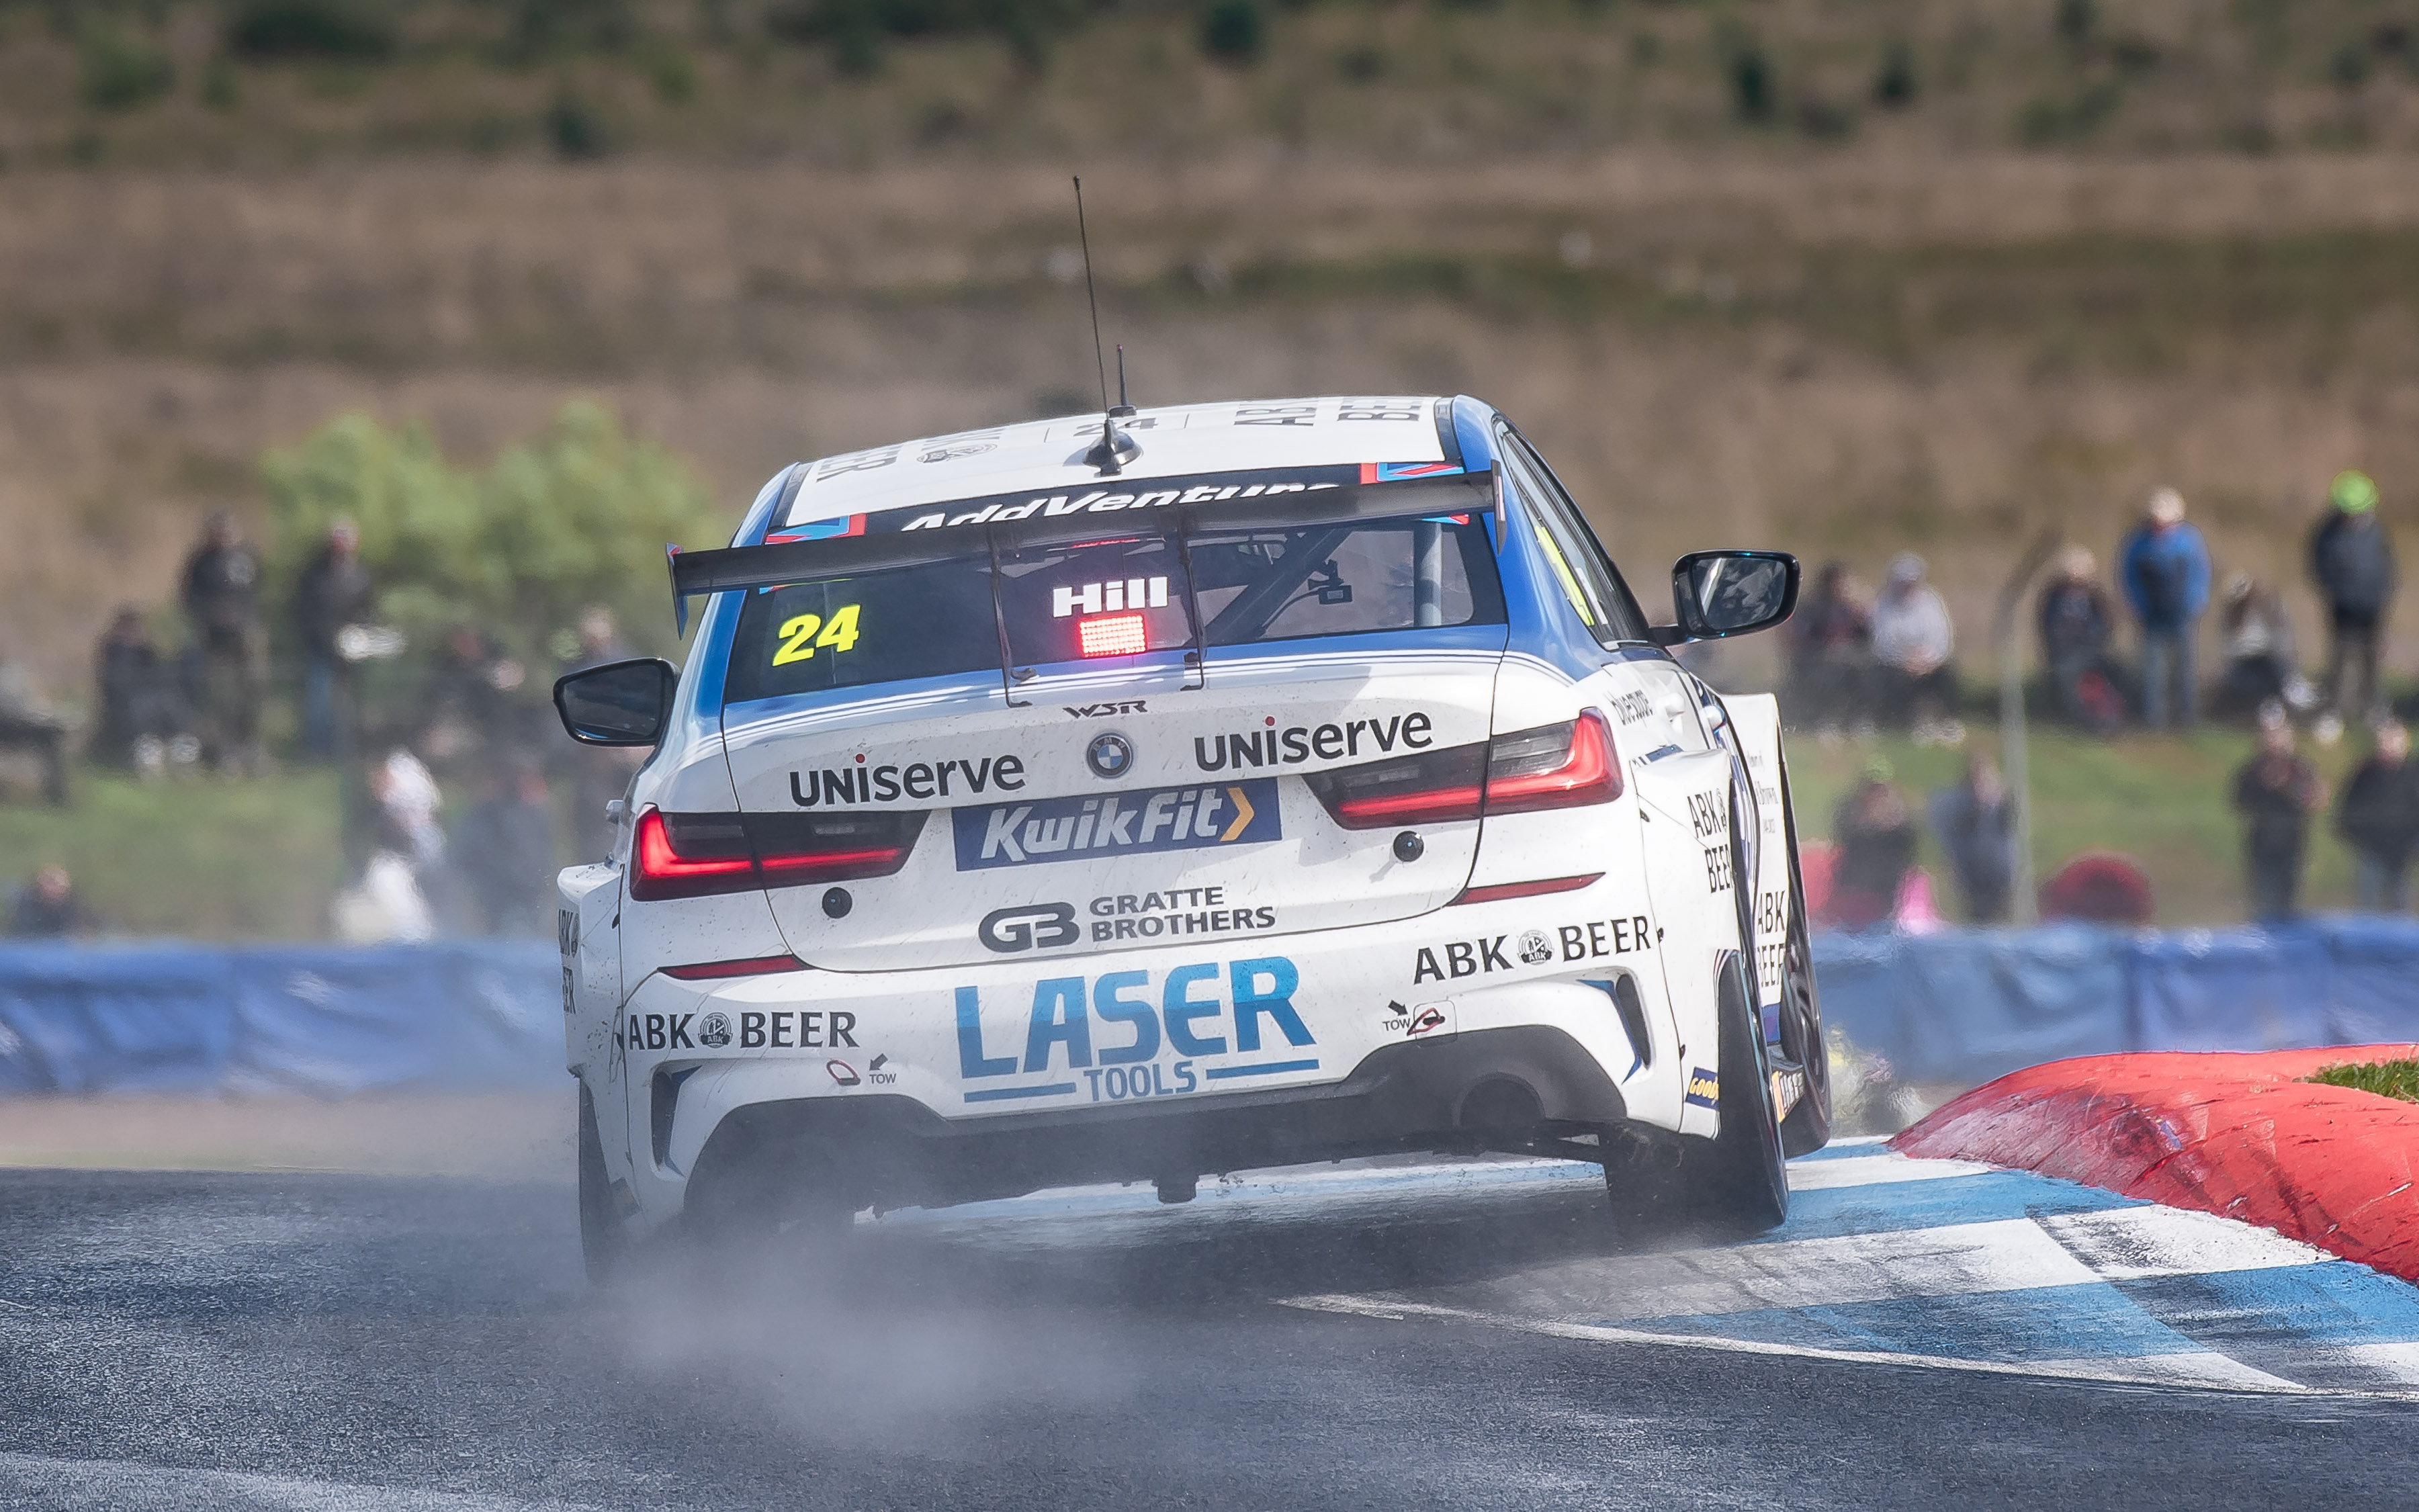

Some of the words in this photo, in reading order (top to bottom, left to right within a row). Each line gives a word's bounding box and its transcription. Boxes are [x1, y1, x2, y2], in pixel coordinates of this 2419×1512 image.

[901, 482, 1342, 531] AddVentur
[1053, 576, 1168, 618] Hill
[772, 604, 861, 666] 24
[1062, 700, 1147, 719] WSR
[1687, 790, 1721, 839] ABK
[1089, 885, 1225, 916] GRATTE
[1757, 890, 1786, 935] ABK
[978, 901, 1080, 953] GB
[1091, 905, 1276, 943] BROTHERS
[1413, 934, 1514, 985] ABK
[1558, 915, 1653, 963] BEER
[629, 1012, 697, 1051] ABK
[739, 1011, 861, 1049] BEER
[955, 956, 1317, 1079] LASER
[1382, 1018, 1411, 1032] TOW
[869, 1073, 897, 1085] TOW
[1083, 1059, 1198, 1102] TOOLS
